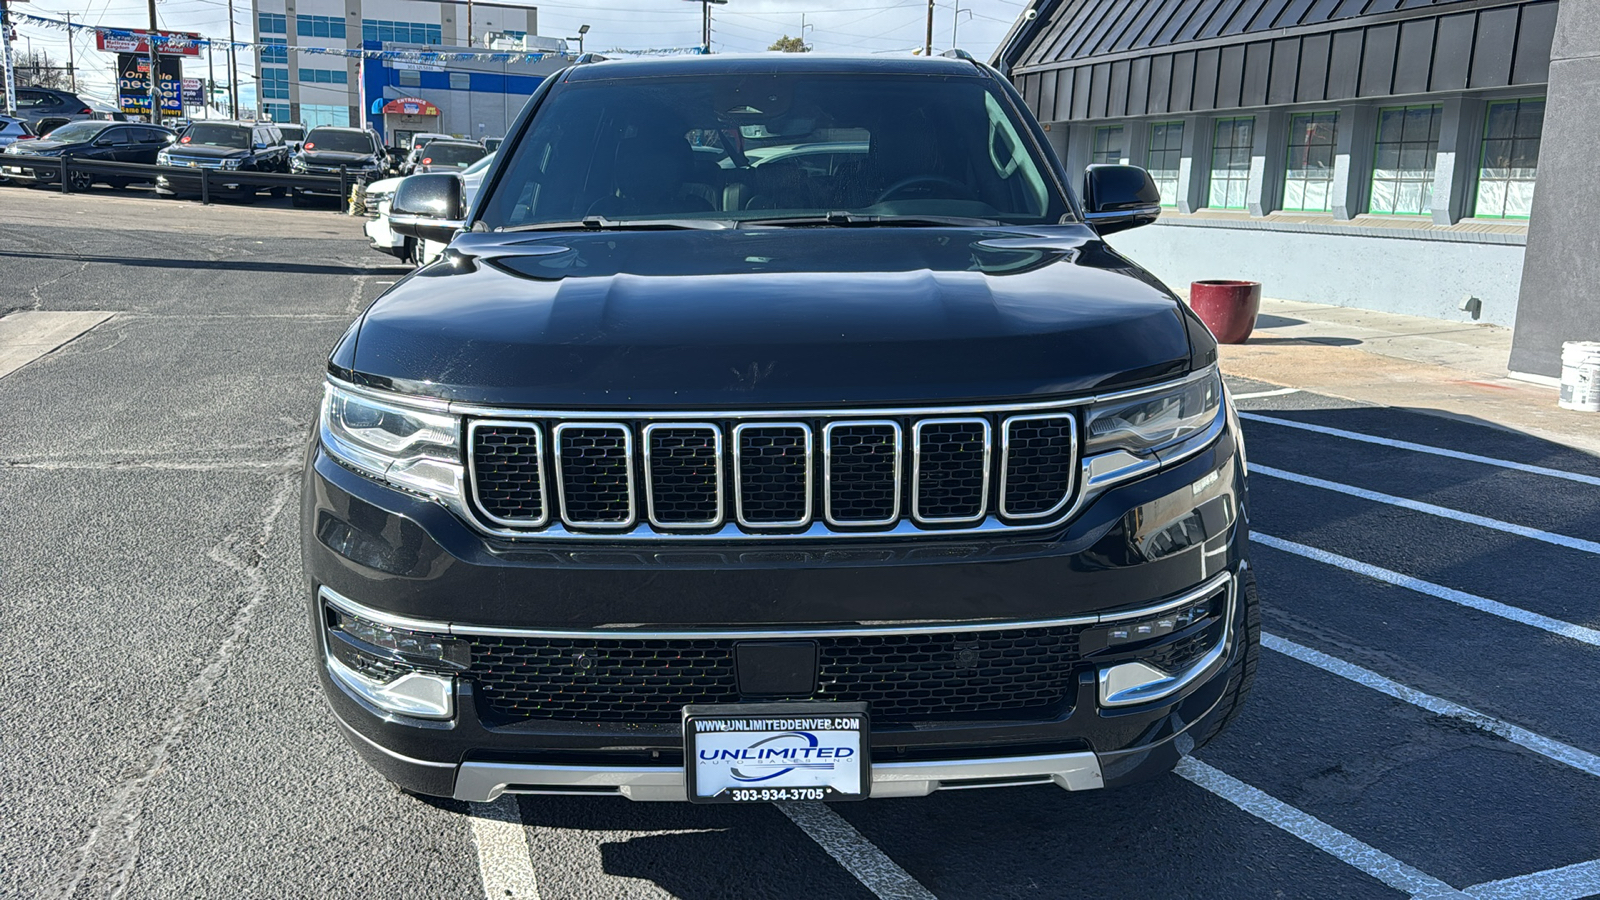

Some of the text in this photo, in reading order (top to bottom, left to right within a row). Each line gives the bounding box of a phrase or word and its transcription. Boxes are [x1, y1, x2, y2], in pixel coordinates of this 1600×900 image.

[125, 71, 142, 79] On
[120, 80, 180, 90] necar
[694, 718, 860, 732] WWW.UNLIMITEDDENVER.COM
[699, 747, 855, 760] UNLIMITED
[732, 789, 824, 801] 303-934-3705
